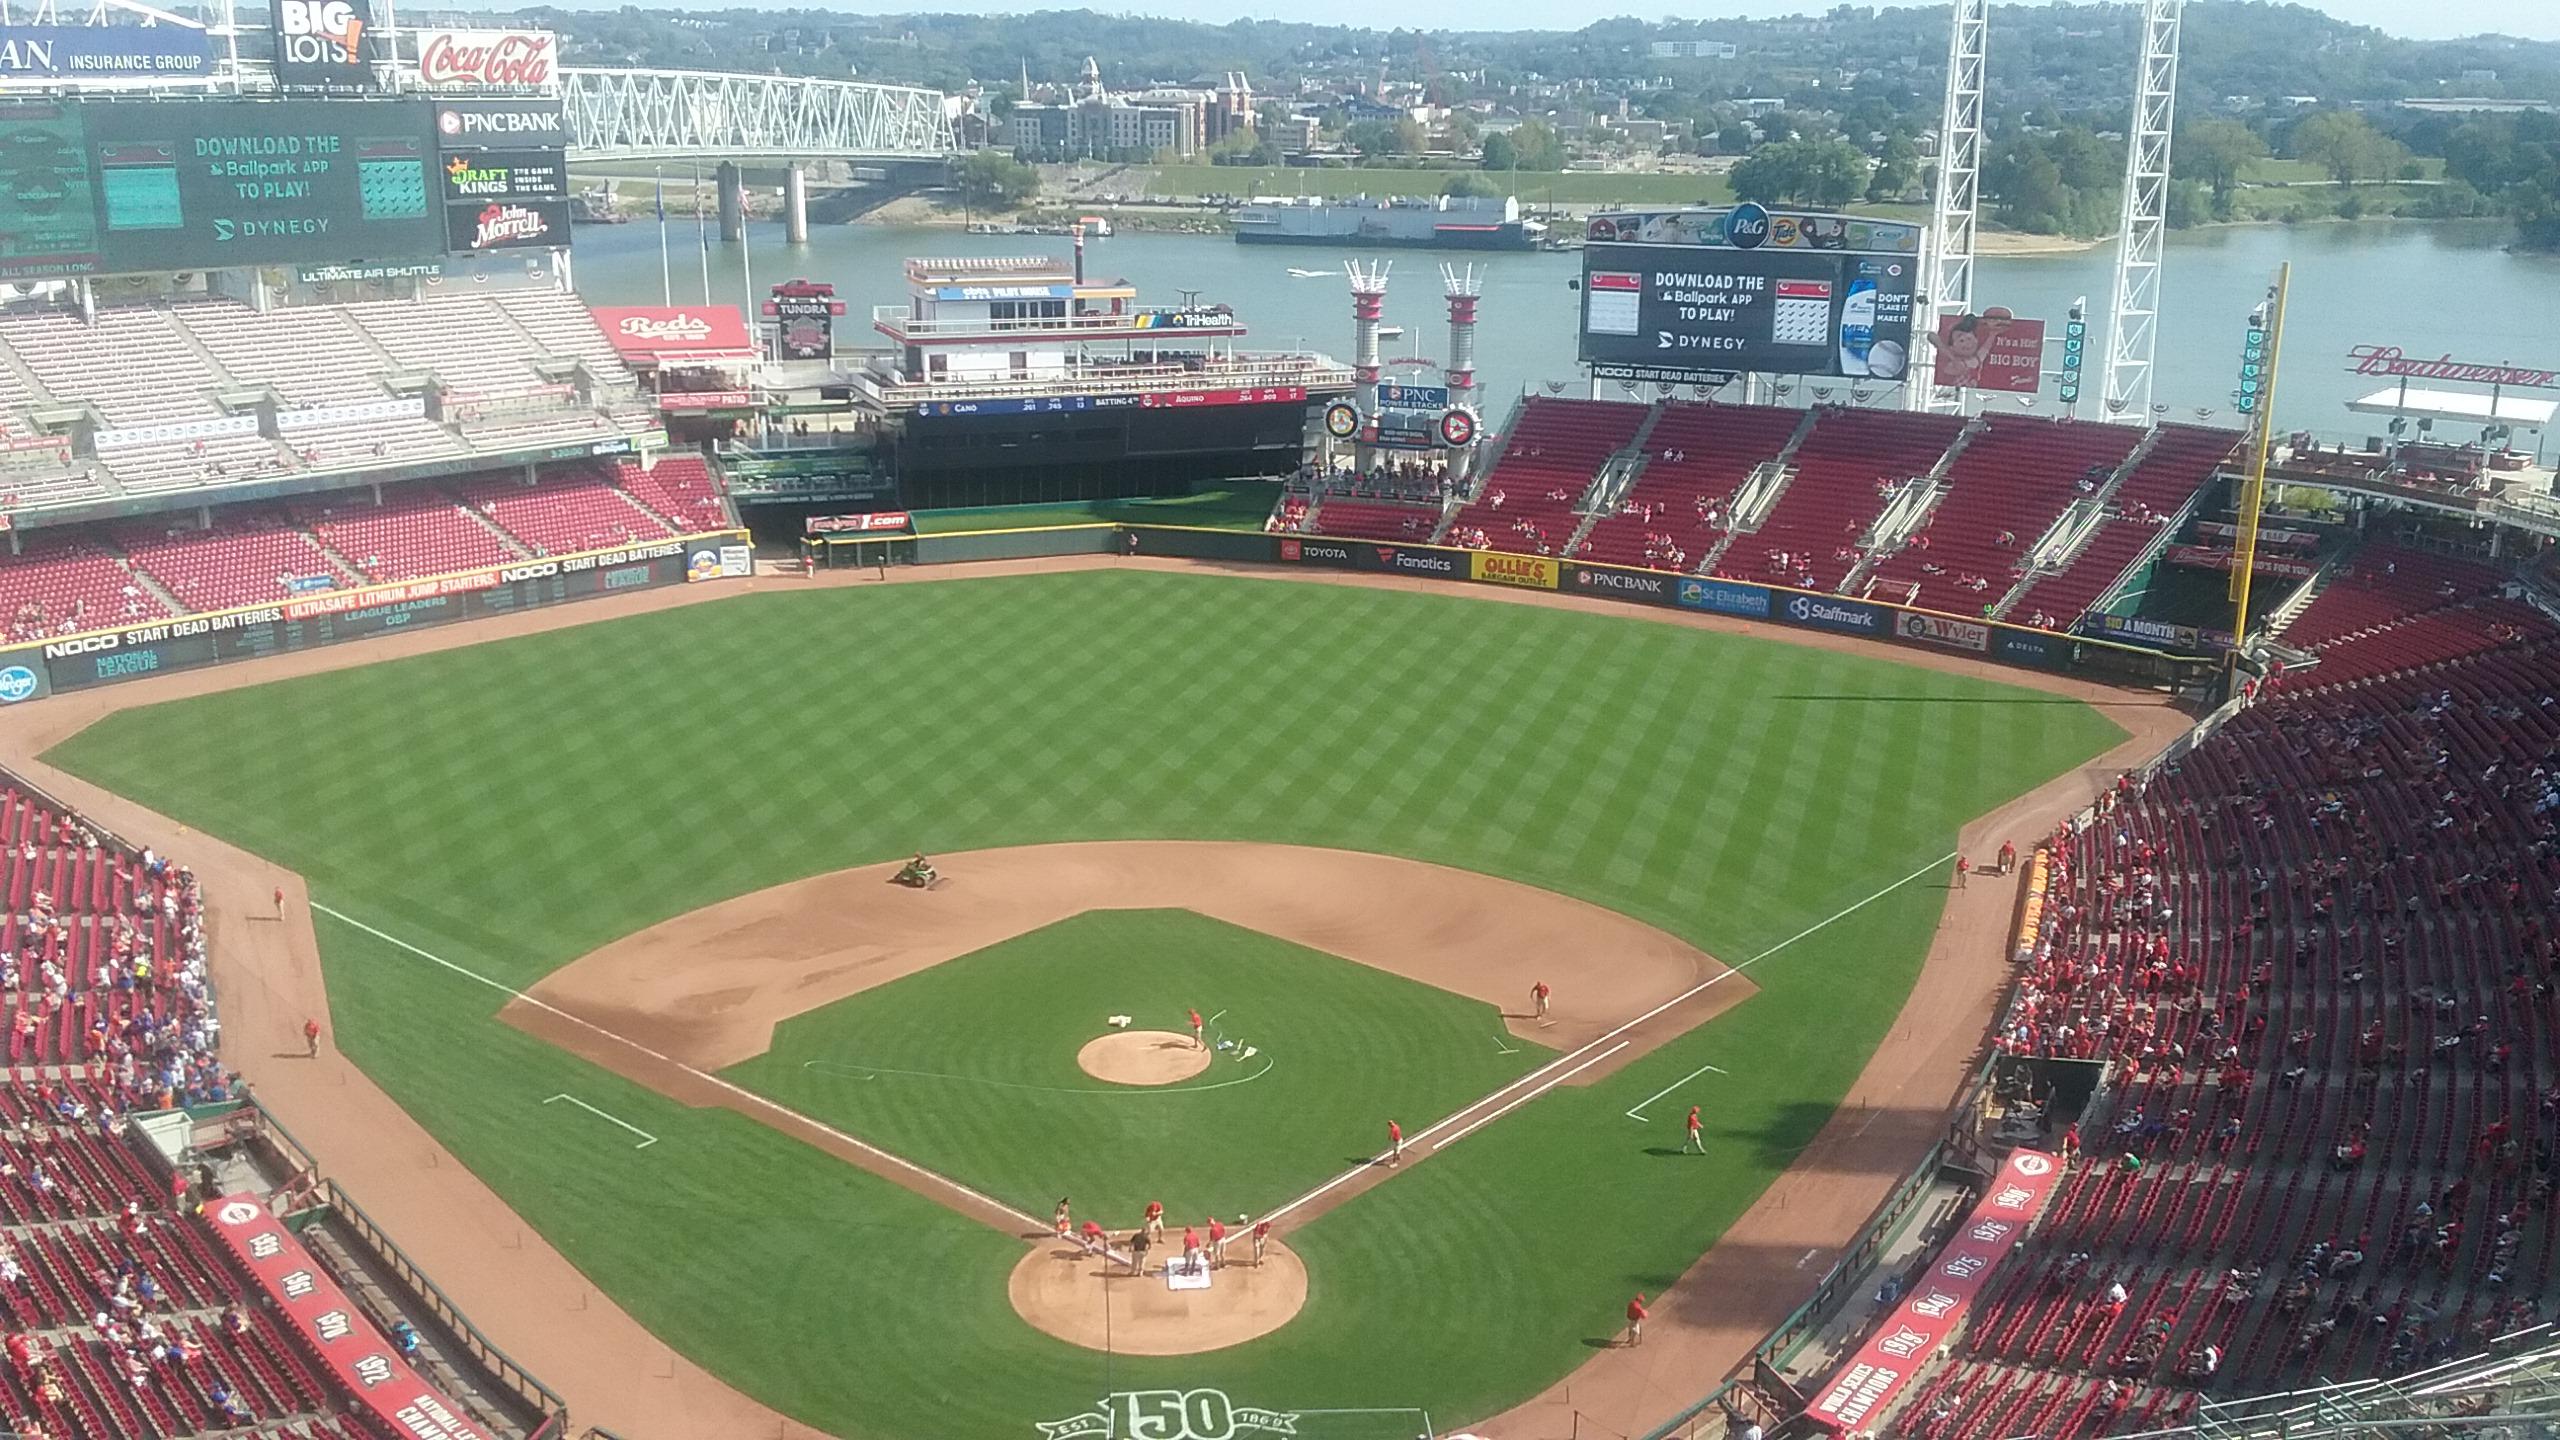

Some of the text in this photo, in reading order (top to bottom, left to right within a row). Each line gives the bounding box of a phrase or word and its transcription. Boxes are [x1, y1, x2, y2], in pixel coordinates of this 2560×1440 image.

[281, 0, 354, 35] BIG
[69, 54, 151, 70] INSURANCE
[155, 54, 202, 70] GROUP
[195, 136, 341, 156] DOWNLOAD THE
[226, 161, 329, 178] Ballpark APP
[452, 163, 509, 184] DRAFT
[236, 181, 311, 199] TO PLAY!
[460, 181, 508, 194] KINGS
[498, 204, 527, 221] John
[243, 218, 329, 236] DYNEGY
[471, 211, 548, 248] Morrell
[1733, 218, 1764, 235] P&G
[1773, 223, 1796, 241] Tide
[2, 262, 95, 277] ALL SEASON LONG
[302, 264, 441, 282] ULTIMATE AIR SHUTTLE
[1655, 272, 1764, 290] DOWNLOAD THE
[1674, 289, 1753, 306] Ballpark APP
[1878, 293, 1910, 303] DON'T
[780, 304, 828, 314] TUNDRA
[1679, 307, 1735, 322] TO PLAY!
[1901, 304, 1909, 312] IT
[620, 313, 712, 339] Reds
[1184, 313, 1232, 327] TriHealth
[1900, 315, 1908, 323] IT
[1679, 334, 1745, 350] DYNEGY
[1989, 354, 2040, 368] BIG BOY
[1594, 365, 1727, 384] NOCO START DEAD BATTERIES.
[954, 404, 977, 413] CANO
[1096, 397, 1126, 406] BATTING
[1175, 395, 1205, 404] AQUINO
[1403, 389, 1436, 401] PNC
[1304, 546, 1347, 559] TOYOTA
[501, 541, 685, 583] NOCO START DEAD BATTERIES.
[1396, 553, 1451, 571] Fanatics
[2273, 564, 2291, 574] FOR
[1481, 572, 1548, 586] BARGAIN OUTLET
[1594, 573, 1662, 593] PNC BANK
[289, 573, 498, 618] ULTRASAFE LITHIUM JUMP STARTERS.
[1716, 590, 1767, 606] Elizabeth
[344, 596, 447, 621] LEAGUE LEADERS
[1811, 601, 1874, 627] Staffmark
[46, 634, 119, 659] NOCO
[126, 626, 170, 645] START
[172, 618, 210, 638] DEAD
[212, 606, 284, 631] BATTERIES.
[1934, 619, 1985, 642] Wyler
[2123, 620, 2132, 631] A
[2133, 620, 2176, 638] MONTH
[2016, 642, 2044, 653] DELTA
[97, 650, 157, 668] NATIONAL
[97, 659, 158, 679] LEAGUE
[1973, 1220, 2008, 1242] 1976
[1947, 1255, 1982, 1278] 1975
[281, 1270, 312, 1297] 1961
[1915, 1292, 1954, 1317] 1940
[355, 1355, 392, 1385] 1972
[1837, 1367, 1899, 1425] CHAMPIONS
[413, 1394, 462, 1433] NATIONAL
[1097, 1388, 1235, 1440] 150
